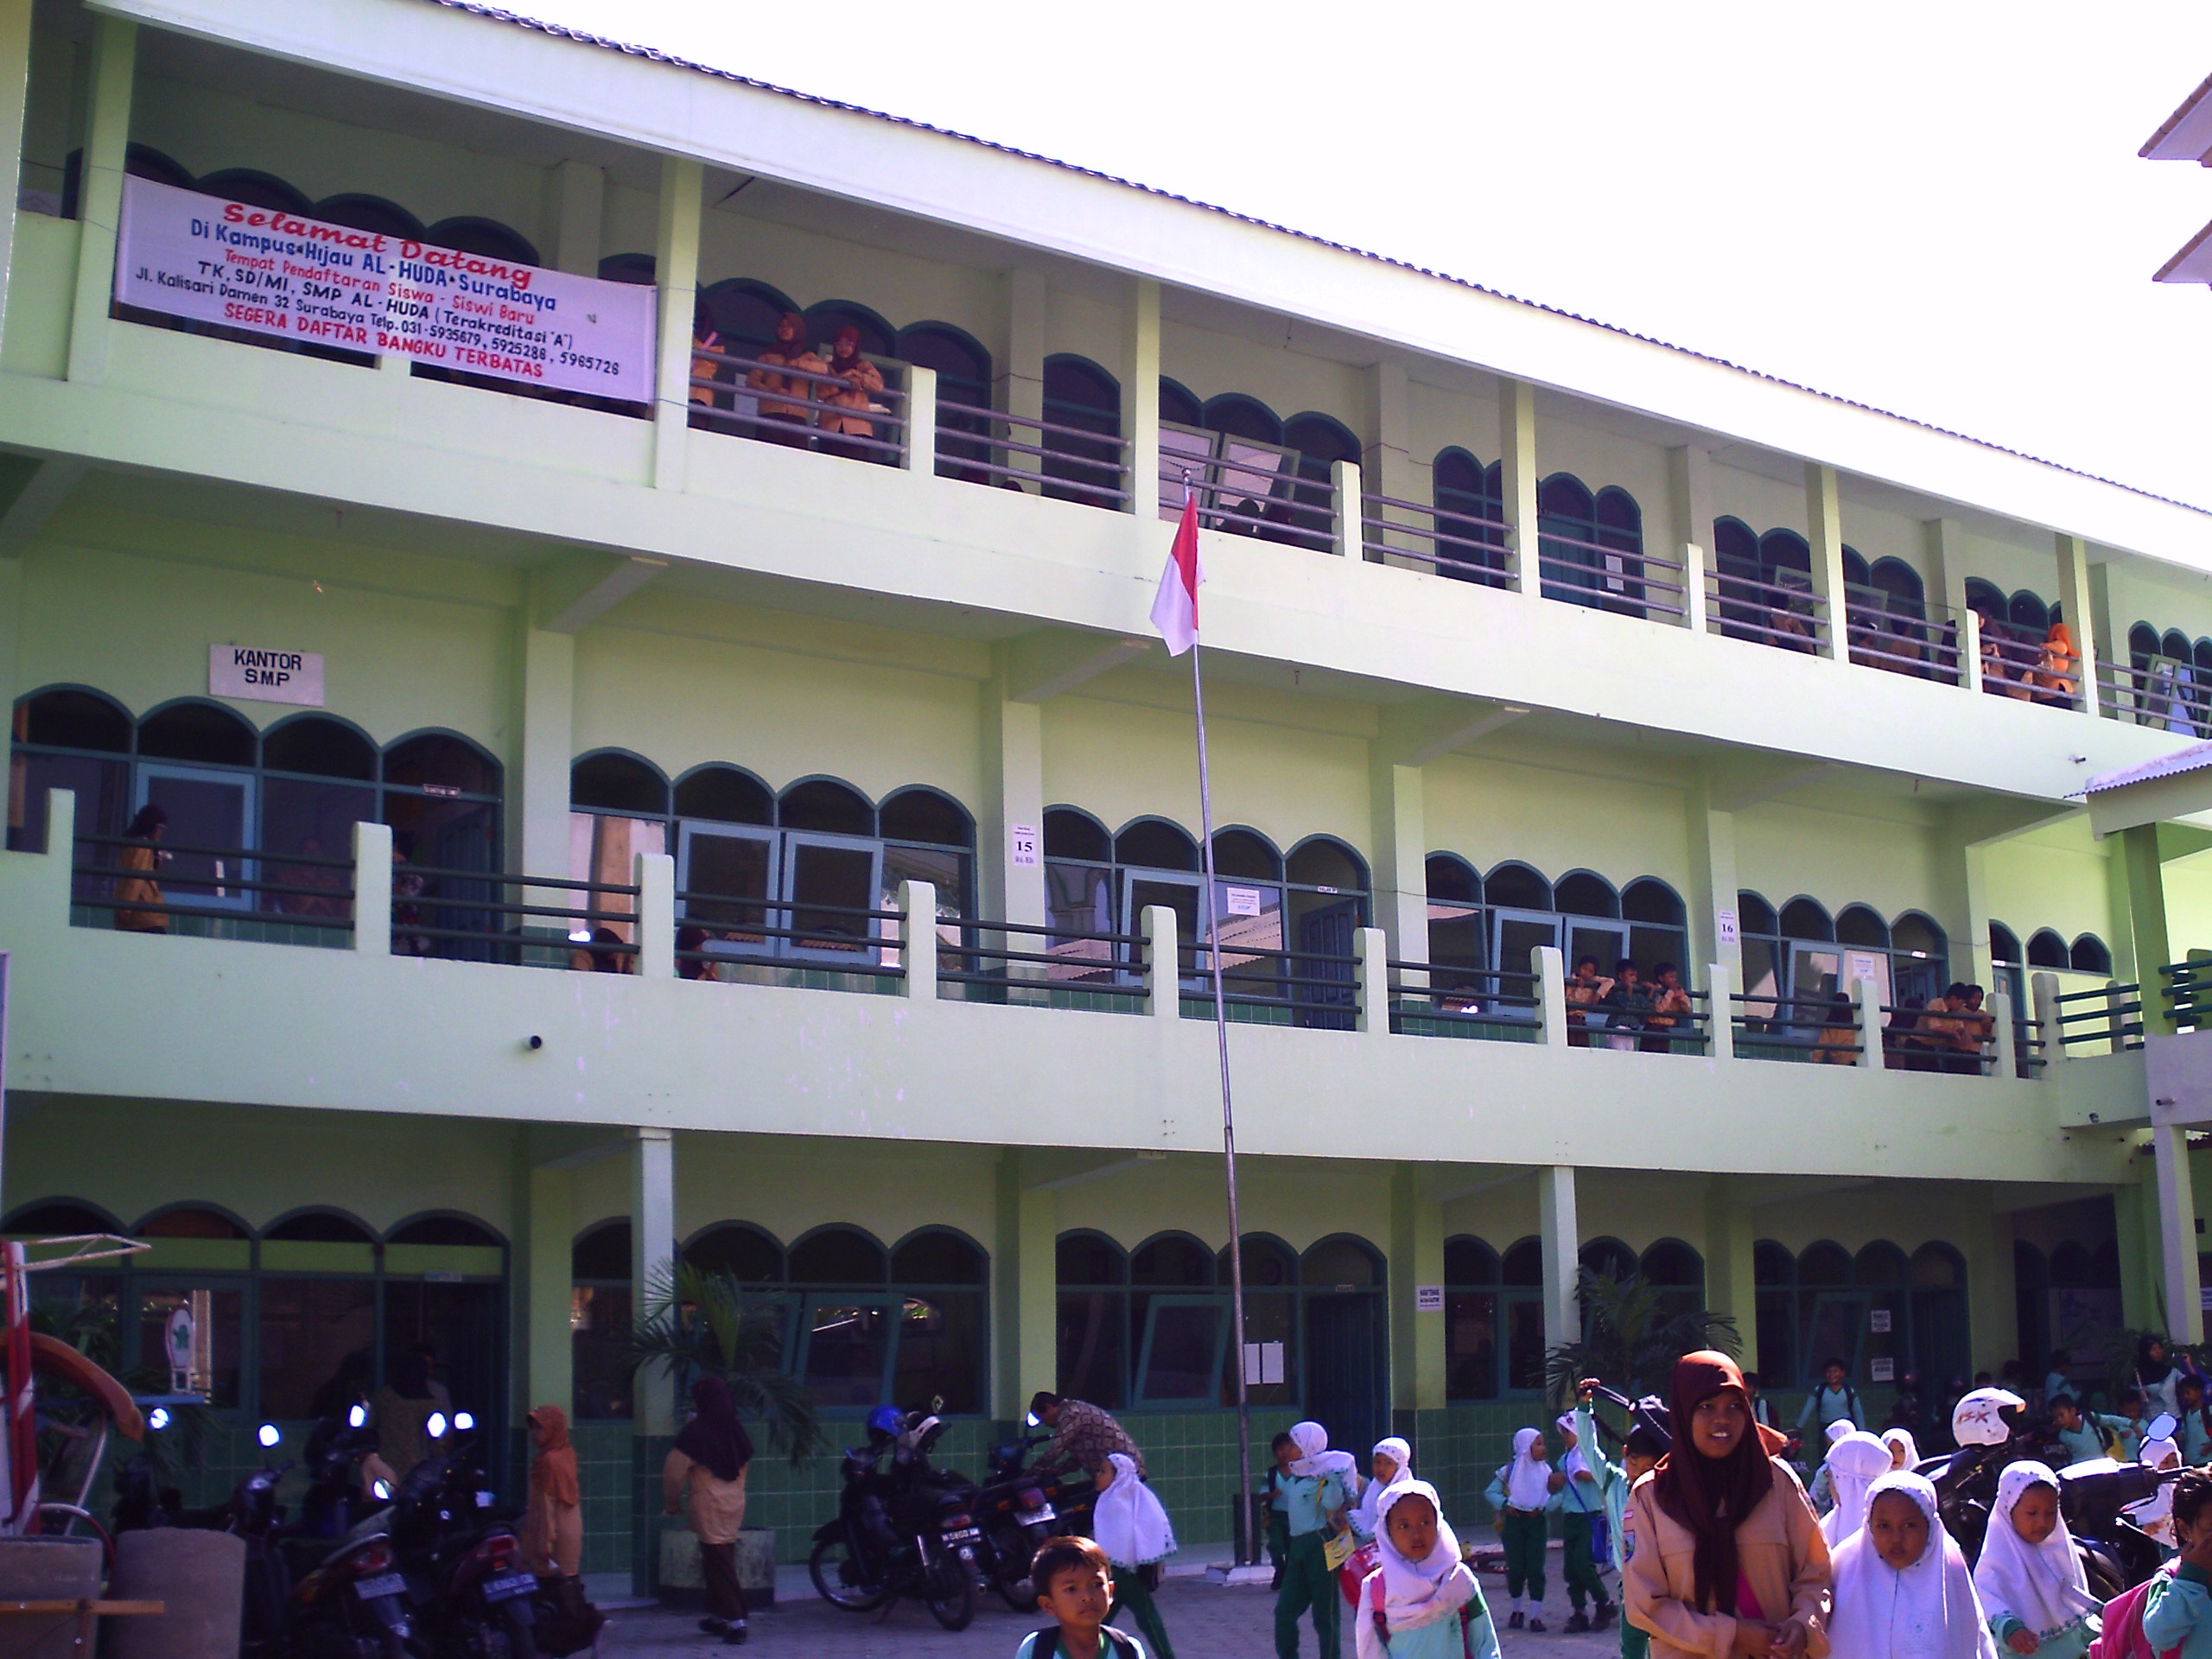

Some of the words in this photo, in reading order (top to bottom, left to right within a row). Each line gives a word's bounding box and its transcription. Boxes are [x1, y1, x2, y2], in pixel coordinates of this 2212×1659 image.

[191, 218, 209, 238] Di
[223, 203, 387, 252] Selamat
[400, 239, 531, 290] Datang
[136, 267, 153, 283] Jl.
[157, 270, 214, 295] Kalisari
[219, 283, 268, 305] Damen
[274, 294, 289, 308] 32
[296, 299, 365, 324] Surabaya
[225, 248, 276, 271] Tempat
[283, 260, 380, 292] Pendaftaran
[388, 282, 434, 303] Siswa
[452, 295, 493, 317] Siswi
[499, 304, 535, 325] Baru
[302, 281, 343, 301] SMP
[224, 302, 287, 328] SEGERA
[296, 316, 367, 344] DAFTAR
[377, 332, 447, 358] BANGKU
[454, 346, 543, 378] TERBATAS
[234, 649, 302, 671] KANTOR
[1017, 841, 1033, 853] 15
[1722, 923, 1733, 933] 16
